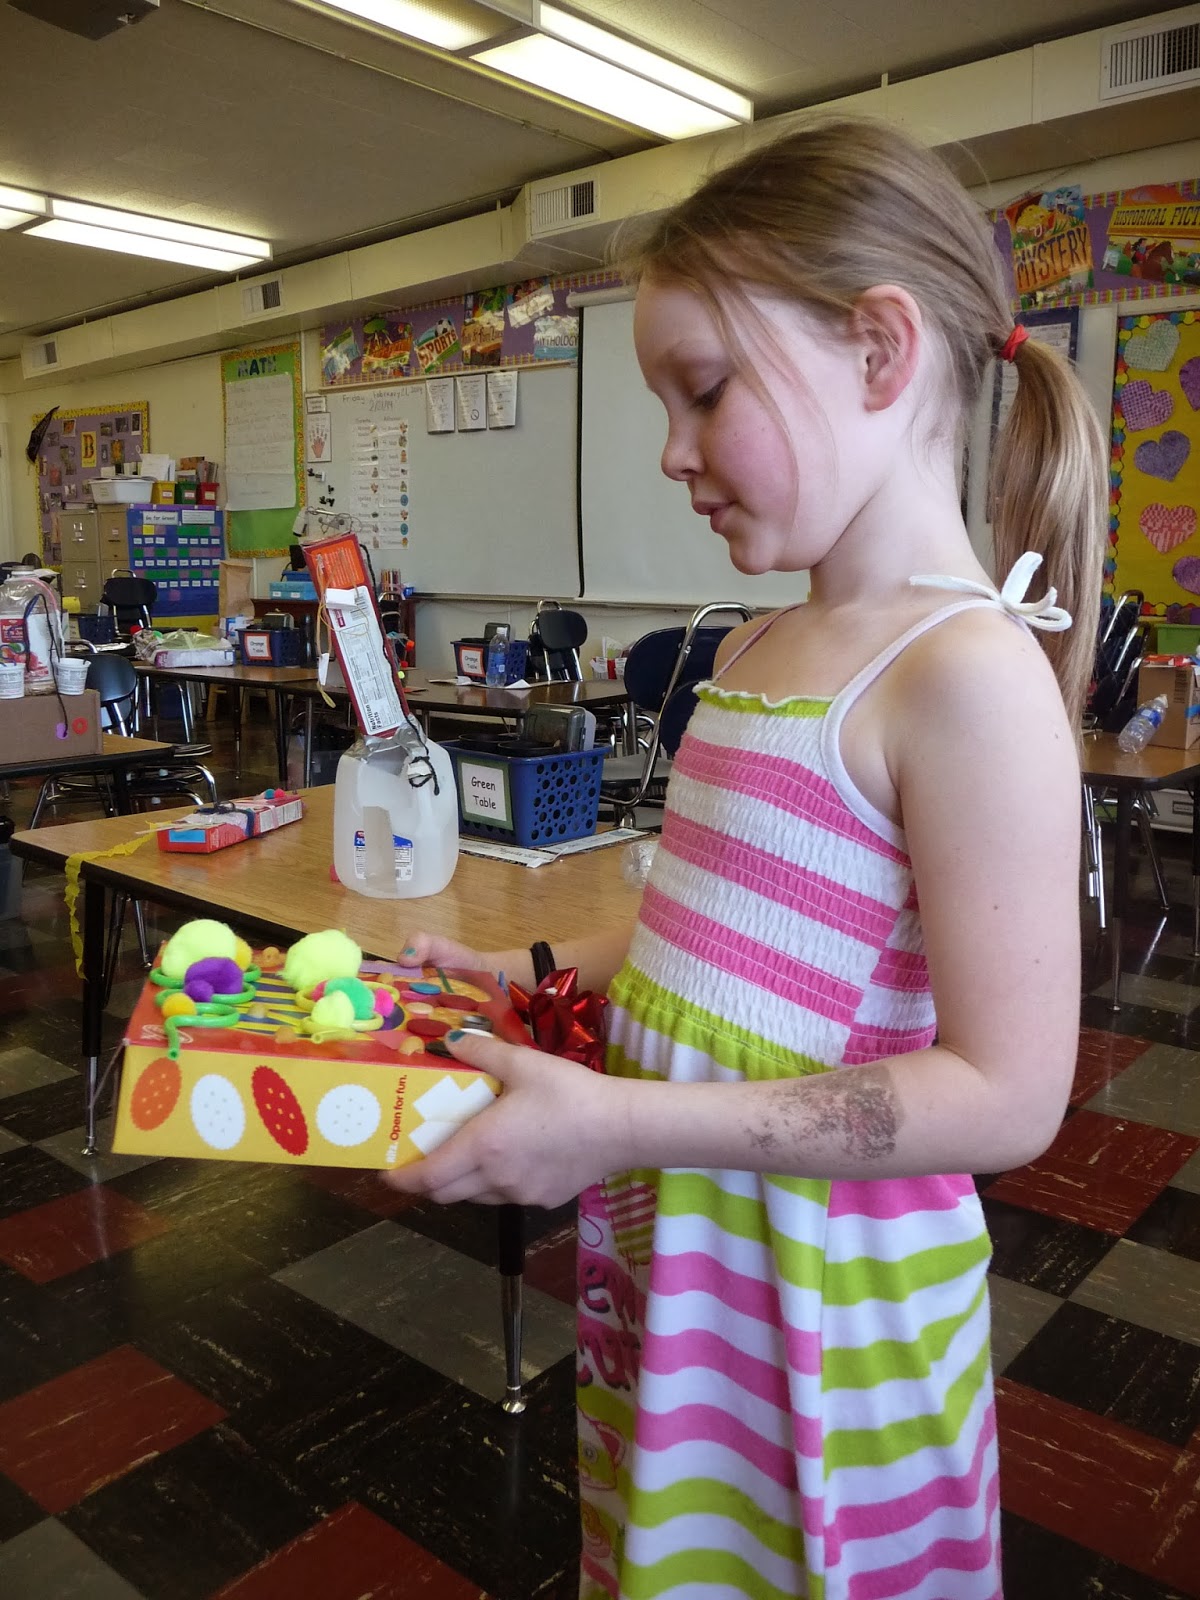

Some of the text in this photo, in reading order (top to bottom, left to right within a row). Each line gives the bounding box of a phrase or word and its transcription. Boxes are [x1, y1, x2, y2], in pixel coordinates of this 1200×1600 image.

[1113, 207, 1167, 226] HISTORICAL
[1015, 227, 1088, 288] MYSTERY
[418, 329, 457, 368] SPORTS
[238, 355, 277, 378] MATH
[471, 776, 497, 791] Green
[472, 794, 498, 809] Table
[393, 1096, 404, 1110] for
[390, 1112, 402, 1141] Open
